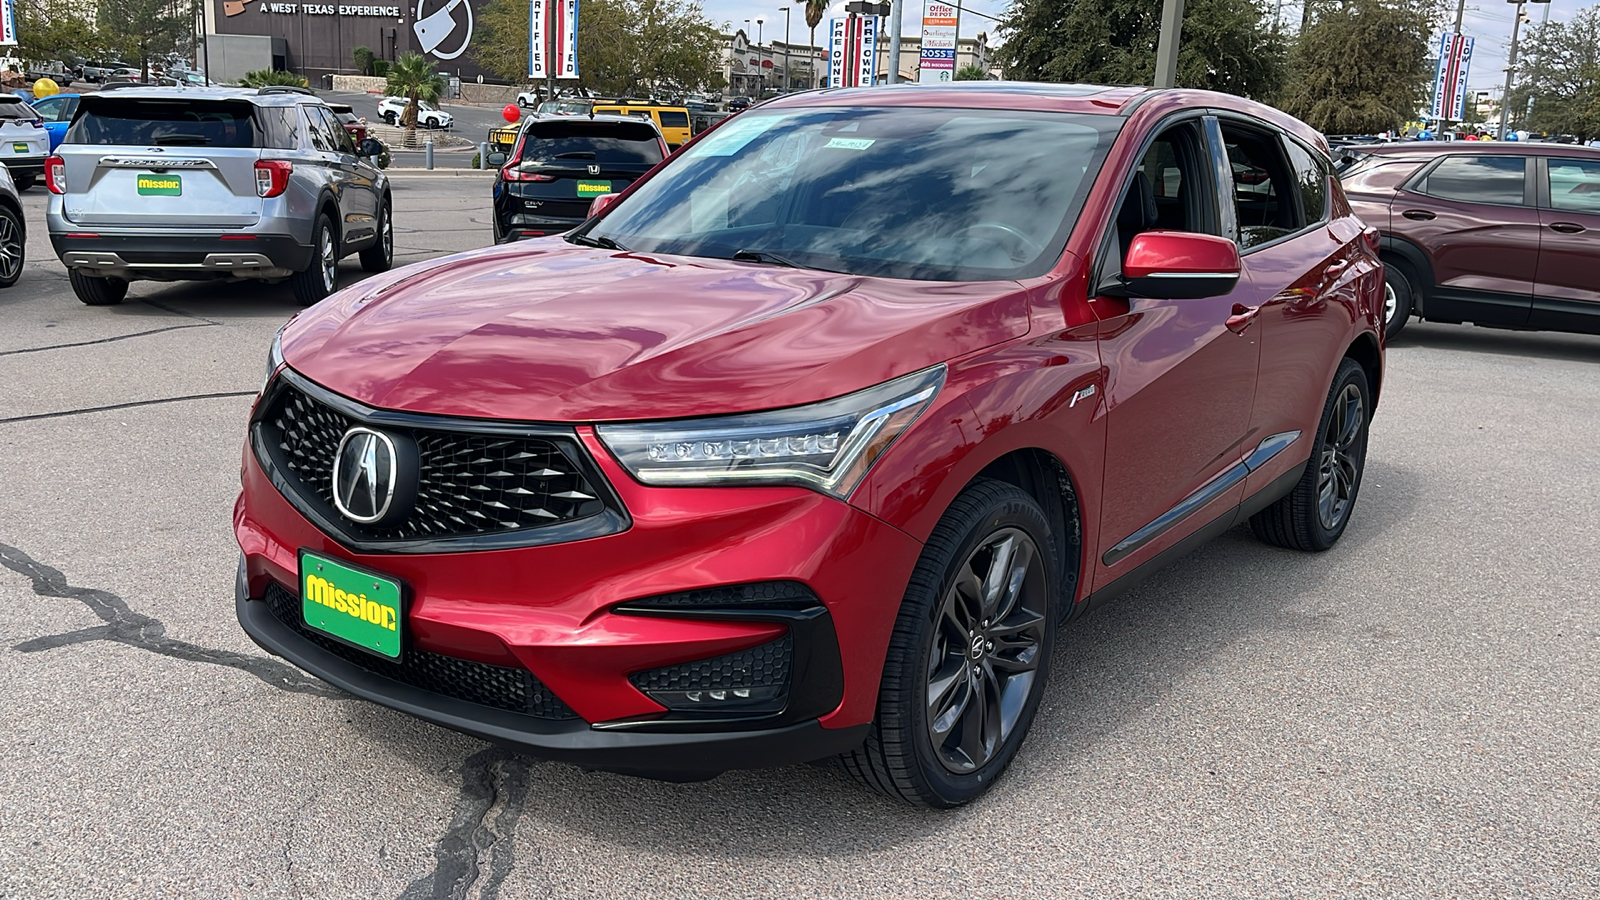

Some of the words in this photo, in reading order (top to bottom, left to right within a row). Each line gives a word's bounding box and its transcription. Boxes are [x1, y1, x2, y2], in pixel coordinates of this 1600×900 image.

[260, 3, 268, 13] A
[270, 3, 297, 14] WEST
[302, 4, 335, 15] TEXAS
[339, 5, 399, 17] EXPERIENCE
[534, 0, 542, 72] RTIFIED
[567, 0, 575, 72] RTIFIED
[834, 22, 843, 46] PRE
[864, 20, 873, 44] PRE
[921, 50, 947, 58] ROSS
[1443, 36, 1451, 60] LOW
[1461, 39, 1470, 63] LOW
[832, 50, 842, 88] OWNE
[862, 49, 872, 84] OWNE
[1435, 68, 1447, 116] PRICES
[1454, 70, 1466, 118] PRICES
[138, 179, 180, 189] Mission
[578, 183, 611, 192] Mission
[306, 574, 396, 632] Mission
